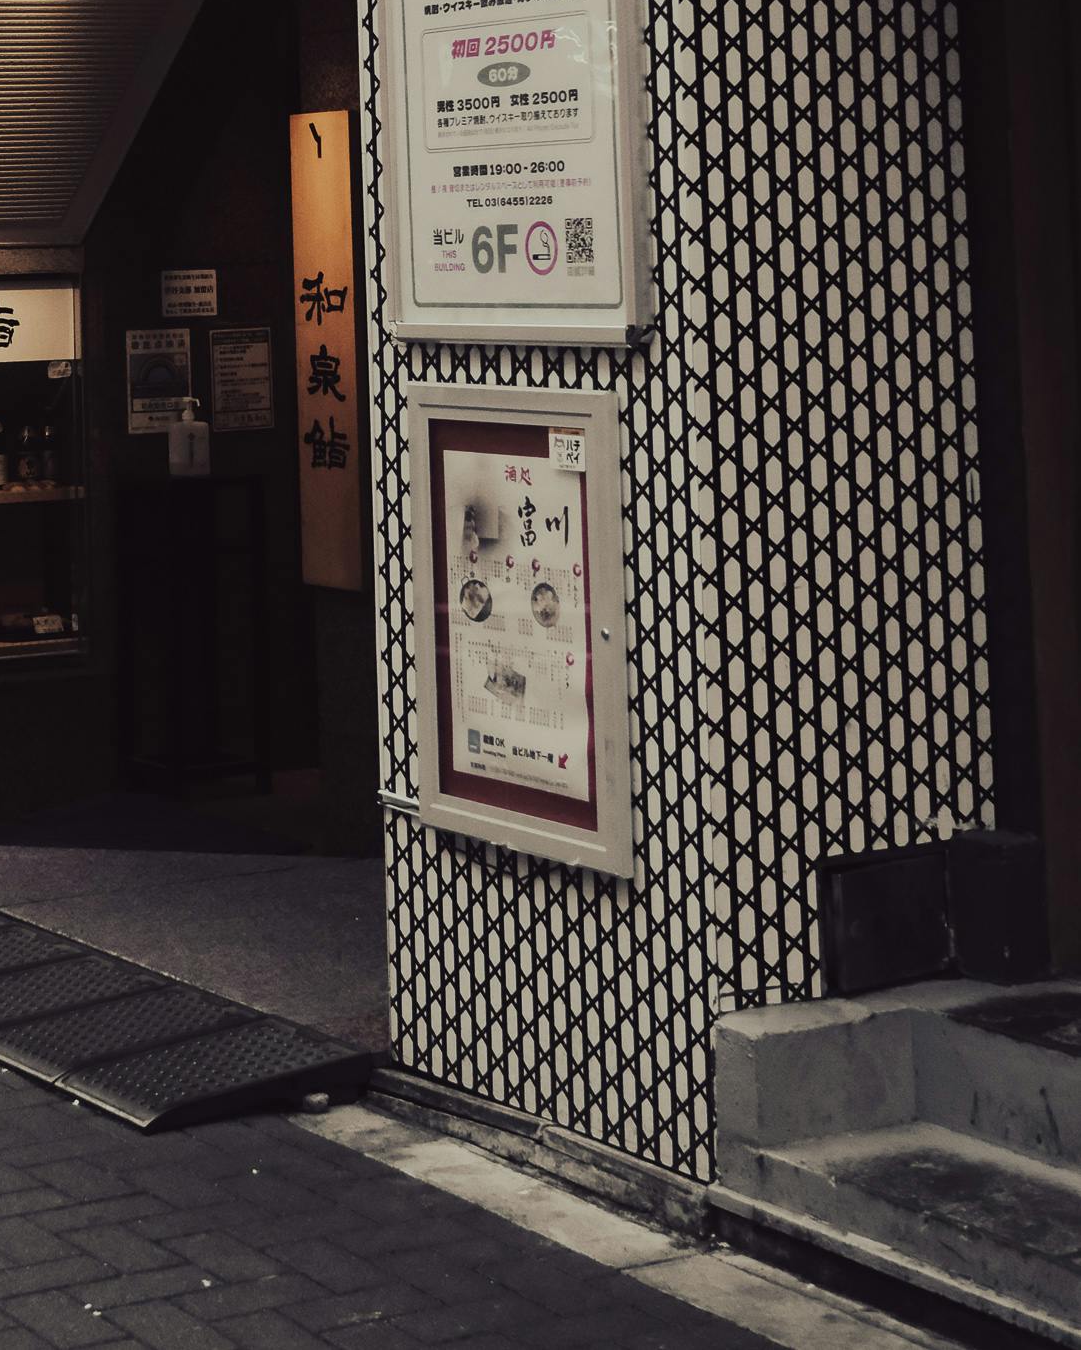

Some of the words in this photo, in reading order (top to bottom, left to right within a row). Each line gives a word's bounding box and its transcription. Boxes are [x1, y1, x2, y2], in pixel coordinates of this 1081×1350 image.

[484, 28, 556, 56] 2500円
[488, 65, 519, 83] 60分
[457, 95, 501, 112] 3500円
[532, 88, 579, 106] 2500円
[489, 162, 522, 176] 19:00
[530, 160, 565, 173] 26:00
[467, 199, 483, 208] TEL
[433, 228, 464, 246] 当ビル
[442, 250, 457, 258] THIS
[472, 224, 518, 274] 6F
[434, 262, 465, 272] BUILDING
[300, 271, 352, 471] 和泉鮨
